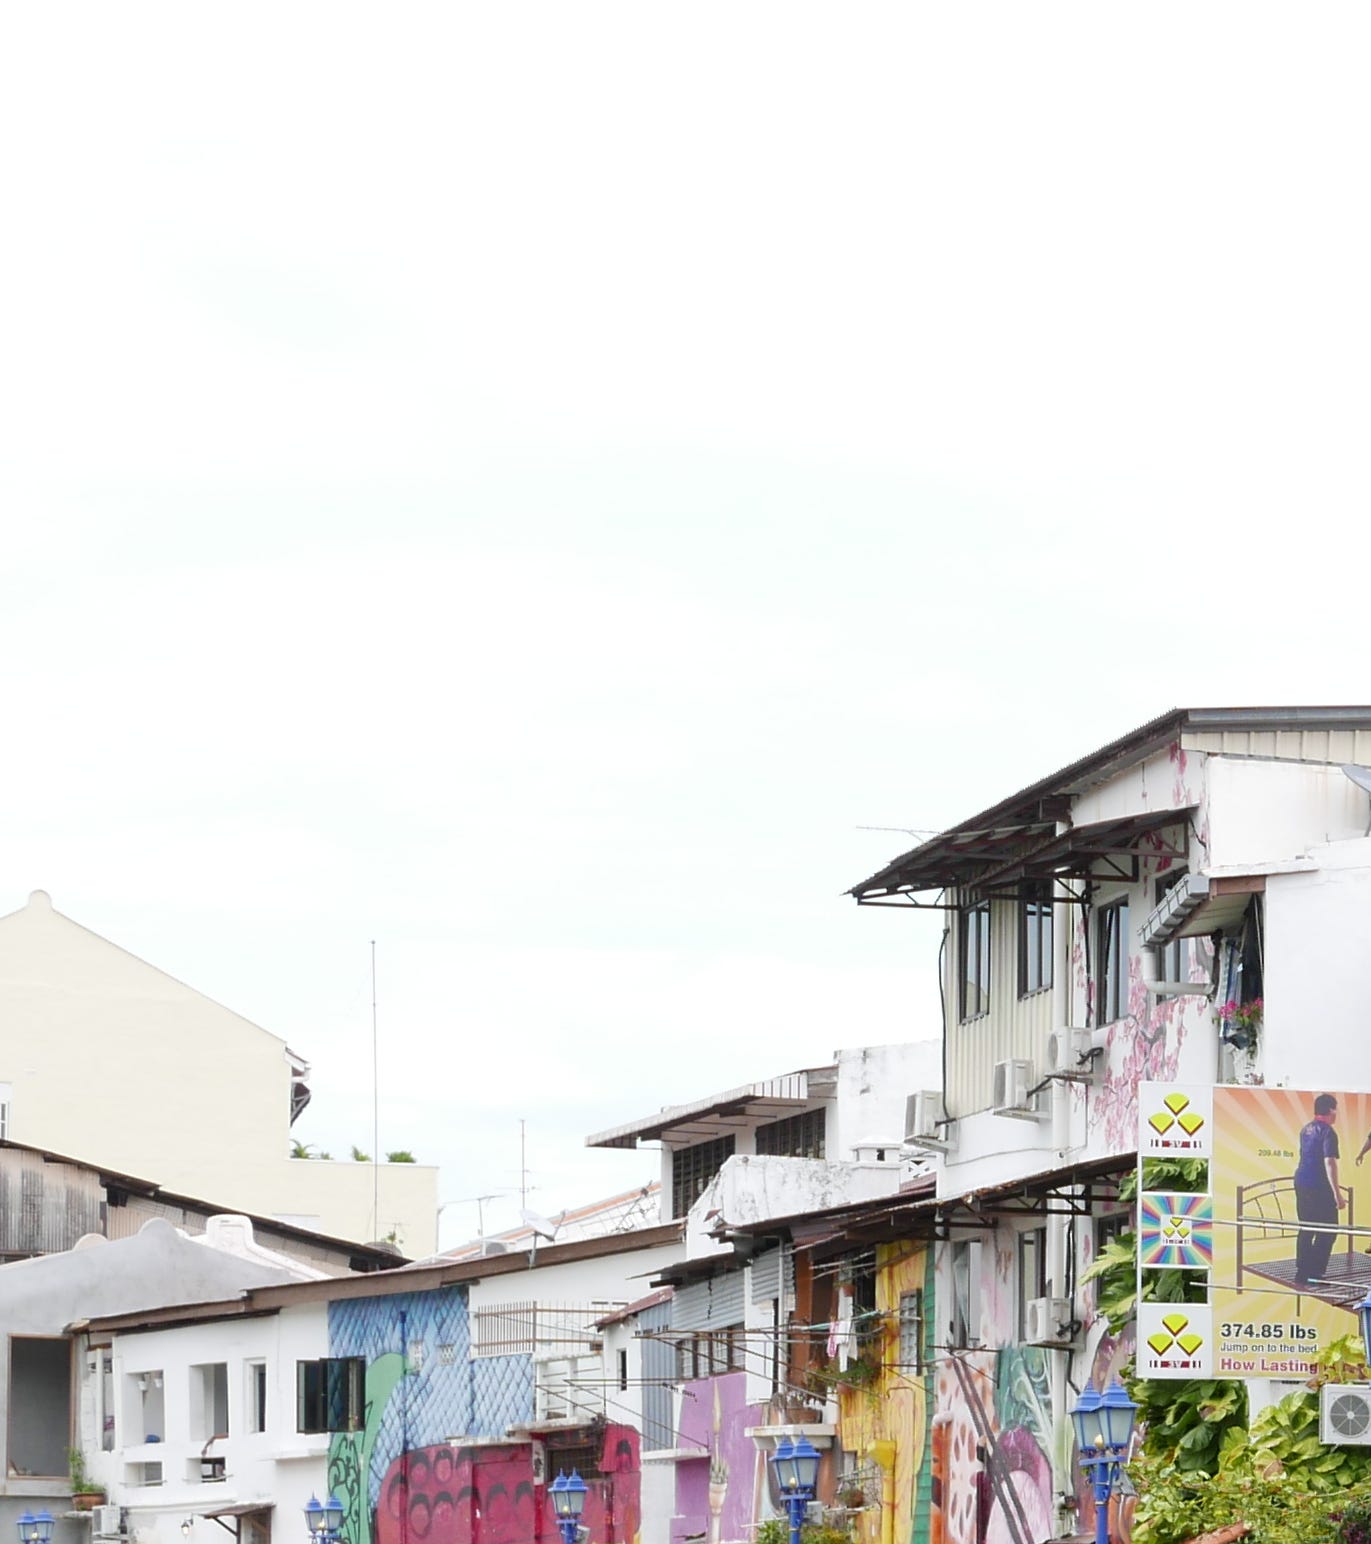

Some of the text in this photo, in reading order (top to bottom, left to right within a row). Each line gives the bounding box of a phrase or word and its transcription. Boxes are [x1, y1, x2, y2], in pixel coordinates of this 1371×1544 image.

[1283, 1150, 1294, 1158] lbs
[1221, 1324, 1317, 1340] 374.85 lbs
[1221, 1343, 1248, 1354] Jump
[1267, 1344, 1277, 1352] to
[1280, 1344, 1295, 1353] the
[1299, 1344, 1317, 1353] bed
[1221, 1358, 1318, 1374] How Lasting
